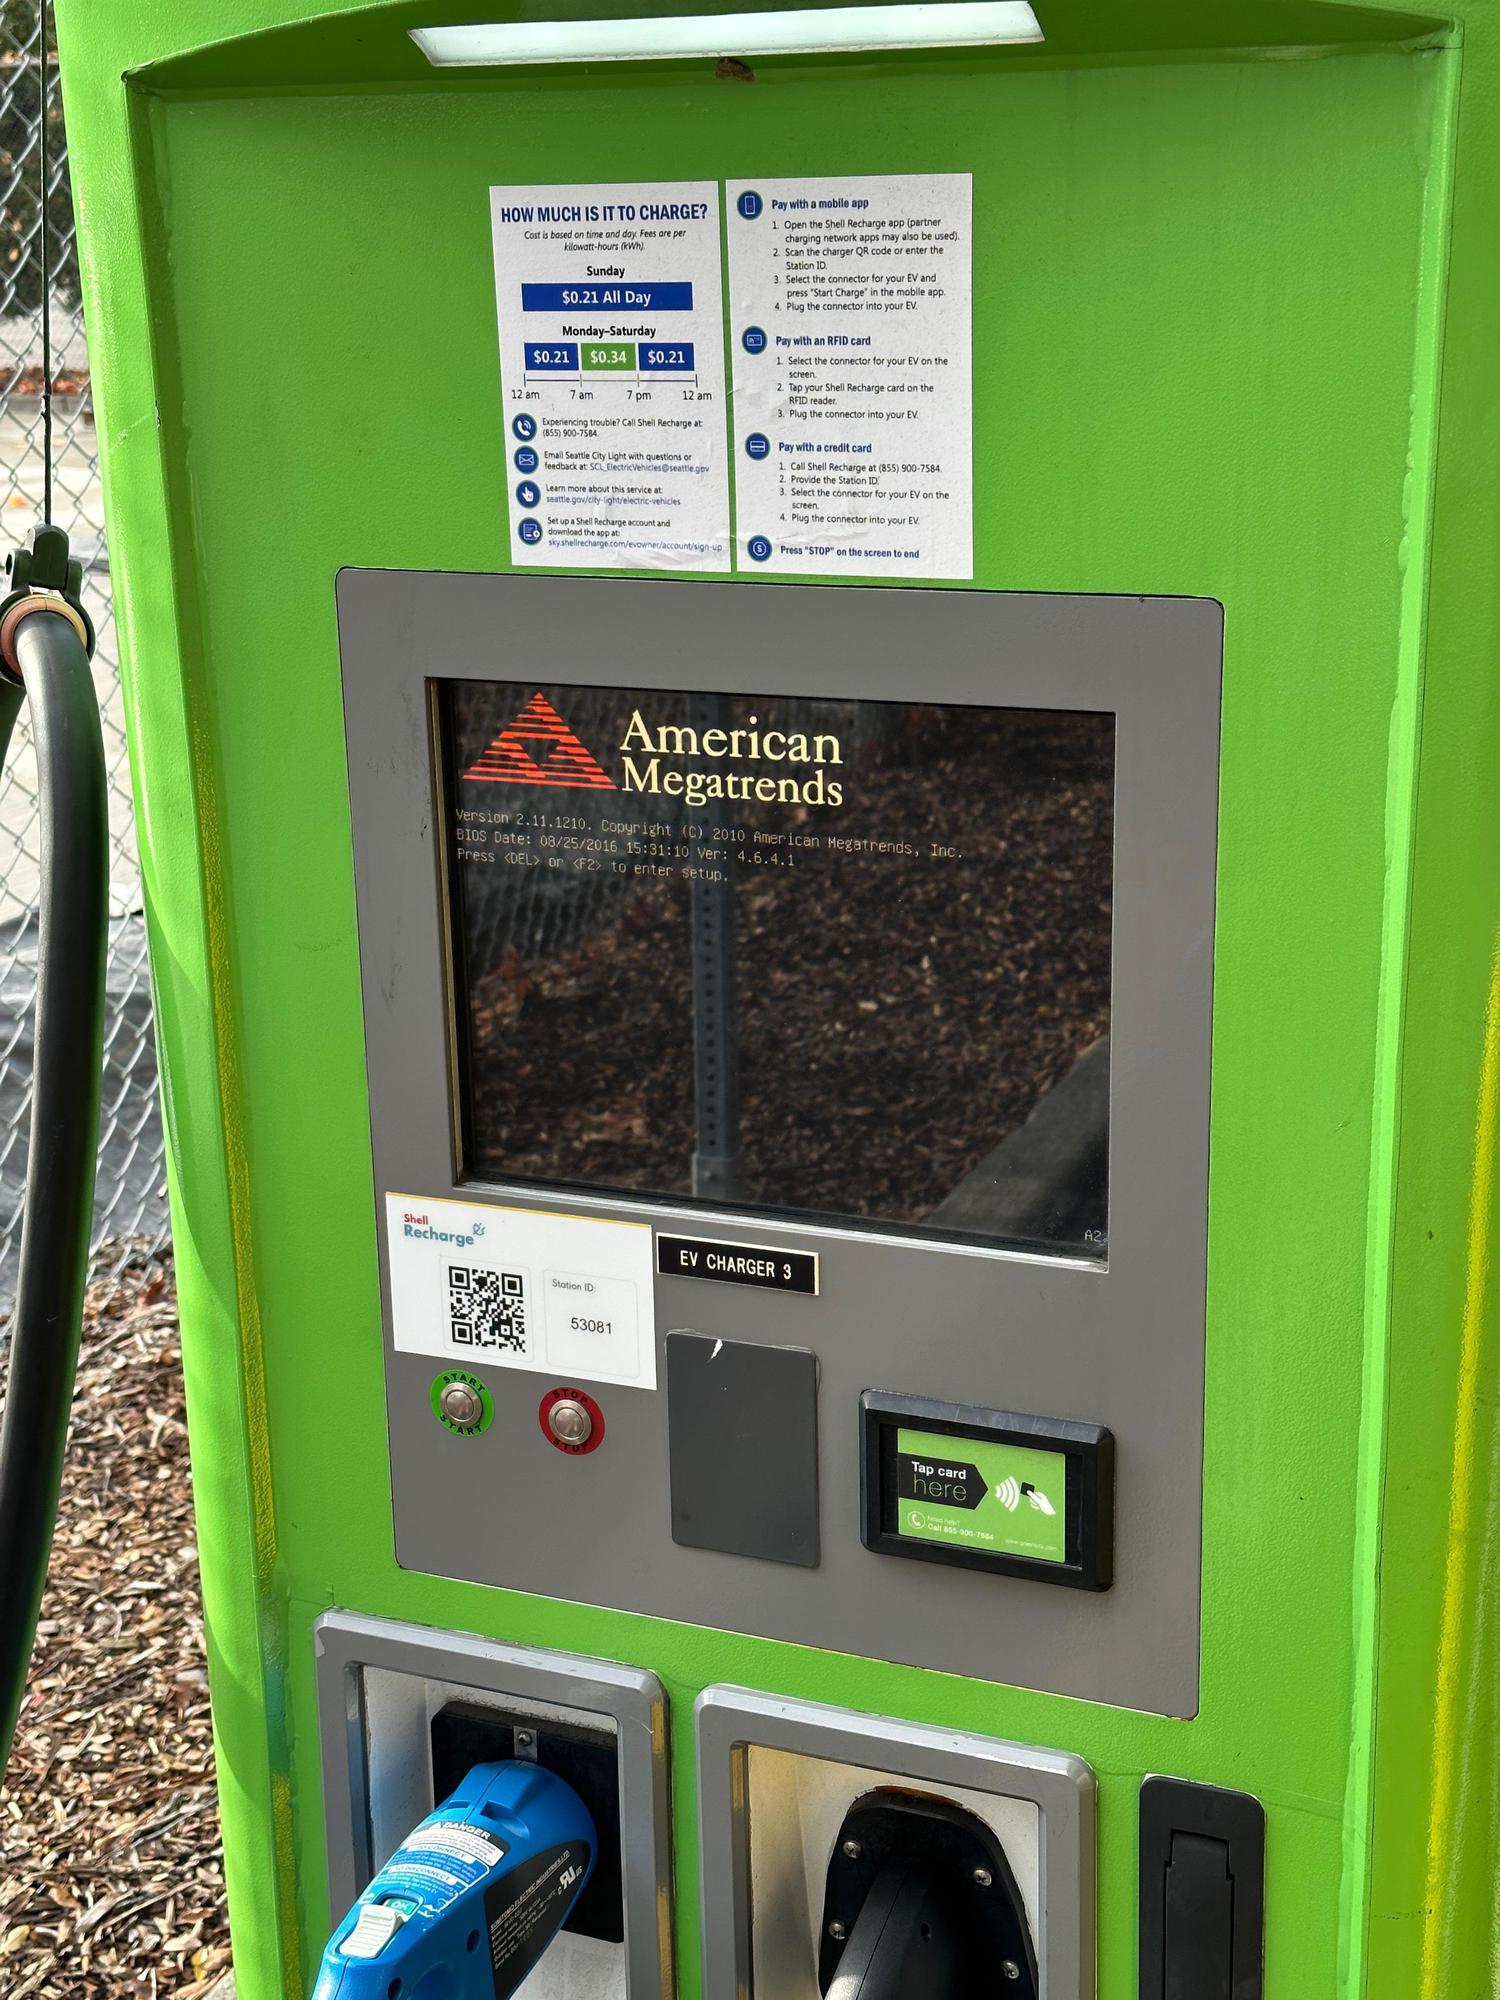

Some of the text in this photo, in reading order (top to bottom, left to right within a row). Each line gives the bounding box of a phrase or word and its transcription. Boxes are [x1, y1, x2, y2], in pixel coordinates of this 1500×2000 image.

[772, 200, 788, 211] Pay
[790, 199, 808, 209] with
[819, 198, 849, 208] mobile
[852, 200, 868, 209] app
[502, 204, 707, 222] HOW MUCH IS IT TO CHARGE?
[773, 218, 941, 231] 1. Open the Shell Recharge app (partner
[524, 231, 540, 239] Cost
[543, 231, 548, 239] is
[551, 230, 572, 239] based
[606, 230, 620, 238] and
[622, 230, 636, 240] day.
[640, 229, 656, 238] Fees
[673, 231, 686, 239] per
[564, 242, 645, 251] kilowatt-hours (kWh).
[587, 265, 625, 278] Sunday
[786, 261, 827, 270] Station ID.
[563, 290, 651, 307] $0.21 All Day
[787, 302, 804, 313] Plug
[807, 302, 820, 310] the
[866, 302, 882, 310] into
[885, 304, 903, 312] your
[906, 301, 917, 310] EV.
[776, 336, 791, 347] Pay
[793, 336, 812, 345] with
[828, 336, 848, 345] RFID
[851, 336, 870, 346] card
[534, 350, 569, 364] $0.21
[591, 350, 626, 364] $0.34
[648, 350, 684, 364] $0.21
[512, 389, 522, 399] 12
[570, 390, 576, 399] 7
[627, 390, 651, 402] 7 pm
[683, 390, 694, 400] 12
[789, 396, 837, 405] RFID reader.
[543, 418, 588, 428] Experiencing
[590, 418, 620, 426] trouble?
[658, 419, 692, 429] Recharge
[543, 429, 599, 438] (855) 900-7584.
[779, 442, 794, 453] Pay
[796, 442, 814, 452] with
[824, 443, 849, 453] credit
[852, 444, 872, 453] card
[544, 451, 563, 459] Email
[566, 451, 590, 459] Seattle
[592, 452, 606, 462] City
[608, 452, 626, 462] Light
[646, 453, 682, 462] questions
[545, 462, 577, 470] feedback
[780, 462, 785, 470] 1.
[791, 462, 805, 470] Call
[808, 462, 826, 471] Shell
[829, 463, 866, 474] Recharge
[879, 464, 899, 473] (855)
[902, 464, 942, 473] 900-7584.
[781, 546, 802, 554] Press
[849, 548, 862, 556] the
[894, 550, 902, 558] to
[904, 550, 919, 558] end
[620, 709, 844, 764] American
[622, 756, 844, 806] Megatrends
[456, 809, 962, 858] Version 2.11.1210. Copyright (C) 2010 American Megatrends, Inc.
[457, 829, 794, 866] BIOS Date: 08/25/2016 15:31:10 Ver: 4.6.4.1
[458, 848, 727, 882] Press <DEL> or <F2> to enter setup.
[404, 1213, 428, 1225] Shell
[404, 1224, 474, 1247] Recharge
[680, 1250, 792, 1280] EV CHARGER 3
[552, 1278, 582, 1291] Station
[570, 1317, 612, 1334] 53081
[442, 1373, 486, 1391] START
[552, 1388, 588, 1404] STOP
[440, 1414, 482, 1435] START
[912, 1461, 966, 1480] Tap card
[914, 1473, 966, 1500] here
[928, 1523, 942, 1532] Call
[442, 1822, 490, 1840] DANGER
[390, 1902, 408, 1910] OK
